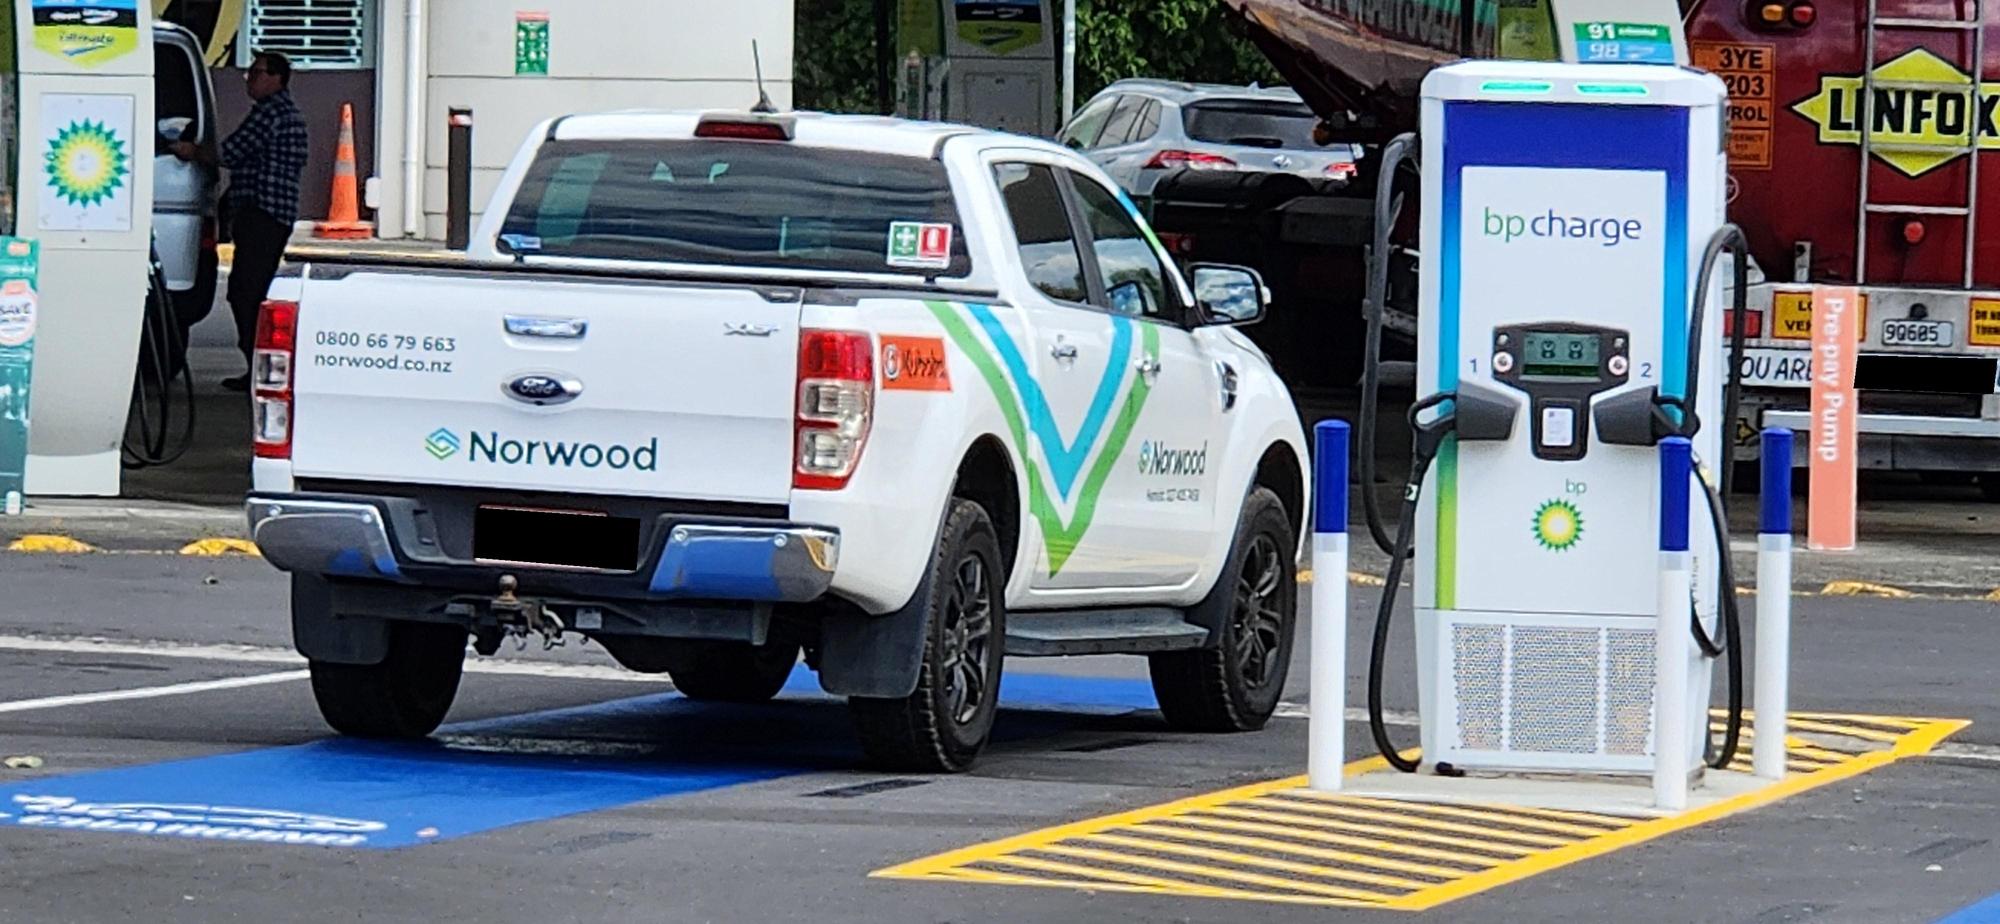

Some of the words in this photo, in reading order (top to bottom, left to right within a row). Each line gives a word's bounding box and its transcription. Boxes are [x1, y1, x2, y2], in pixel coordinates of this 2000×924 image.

[1587, 23, 1616, 40] 91
[1589, 42, 1620, 58] 98
[1720, 48, 1765, 70] 3YE
[1829, 87, 2000, 139] LINFOX
[1484, 206, 1525, 243] bp
[1530, 208, 1642, 247] charge
[316, 331, 360, 347] 0800
[366, 333, 388, 349] 66
[394, 335, 416, 350] 79
[424, 336, 456, 352] 663
[1818, 296, 1846, 387] Pre-pay
[314, 351, 454, 373] norwood.co.nz
[1469, 358, 1478, 373] 1
[1640, 362, 1653, 379] 2
[1817, 391, 1845, 463] Pump
[468, 431, 658, 473] Norwood
[1148, 438, 1208, 475] Norwood
[1565, 478, 1588, 497] bp
